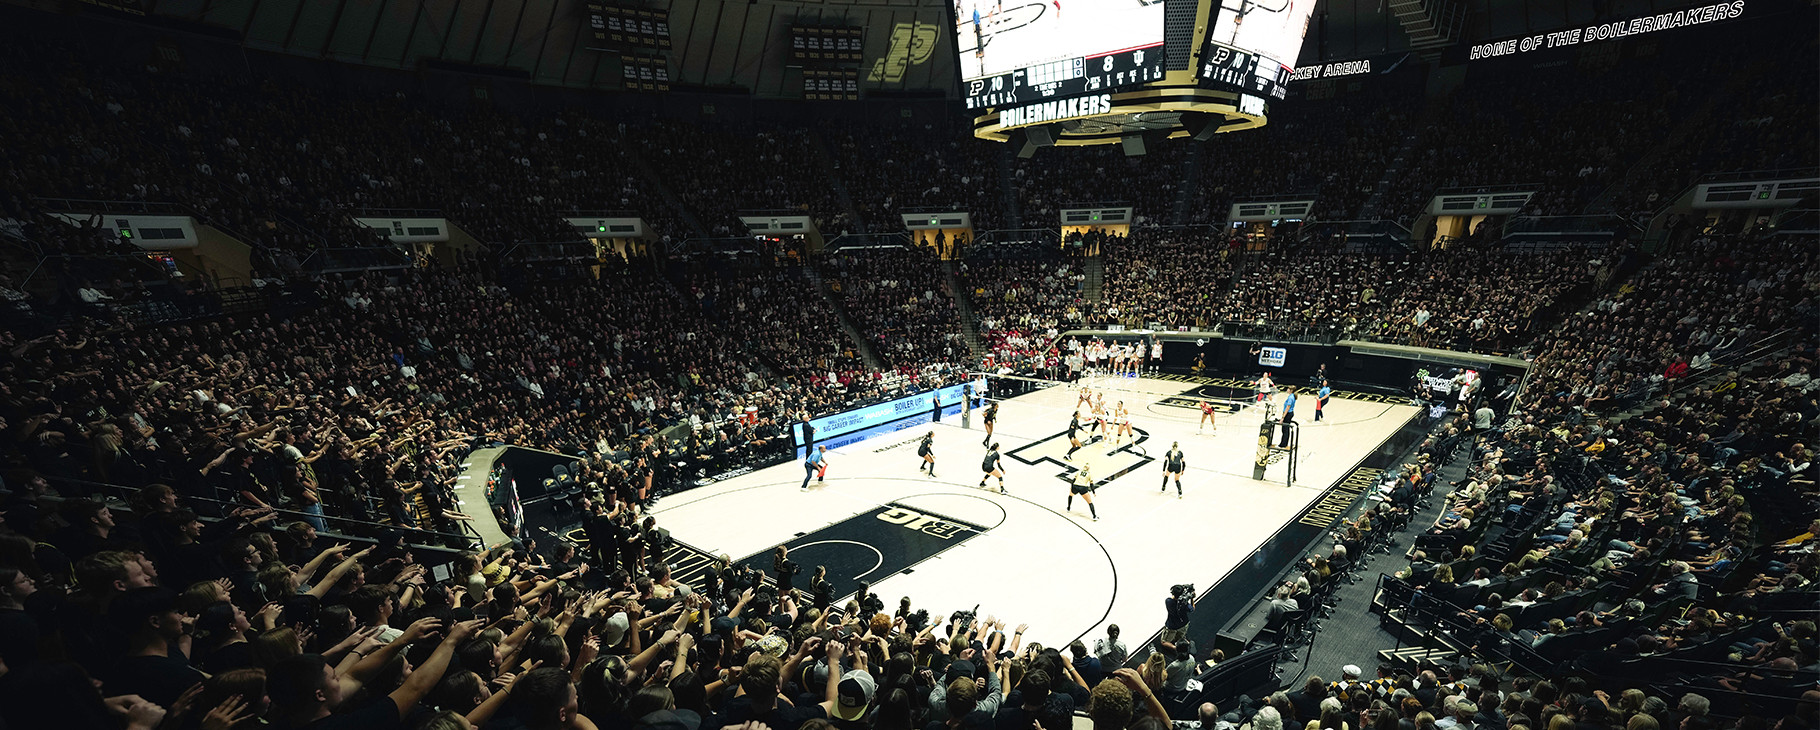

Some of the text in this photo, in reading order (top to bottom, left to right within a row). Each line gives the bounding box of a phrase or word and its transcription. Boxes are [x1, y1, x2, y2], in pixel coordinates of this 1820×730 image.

[1470, 1, 1744, 60] HOME OF THE BOILERMAKERS
[1103, 55, 1114, 72] 8
[1233, 52, 1245, 69] 10
[1322, 60, 1370, 78] ARENA
[991, 76, 1004, 92] 10
[999, 94, 1111, 129] BOILERMAKERS
[865, 407, 894, 420] WABASH
[895, 399, 914, 411] BOILER
